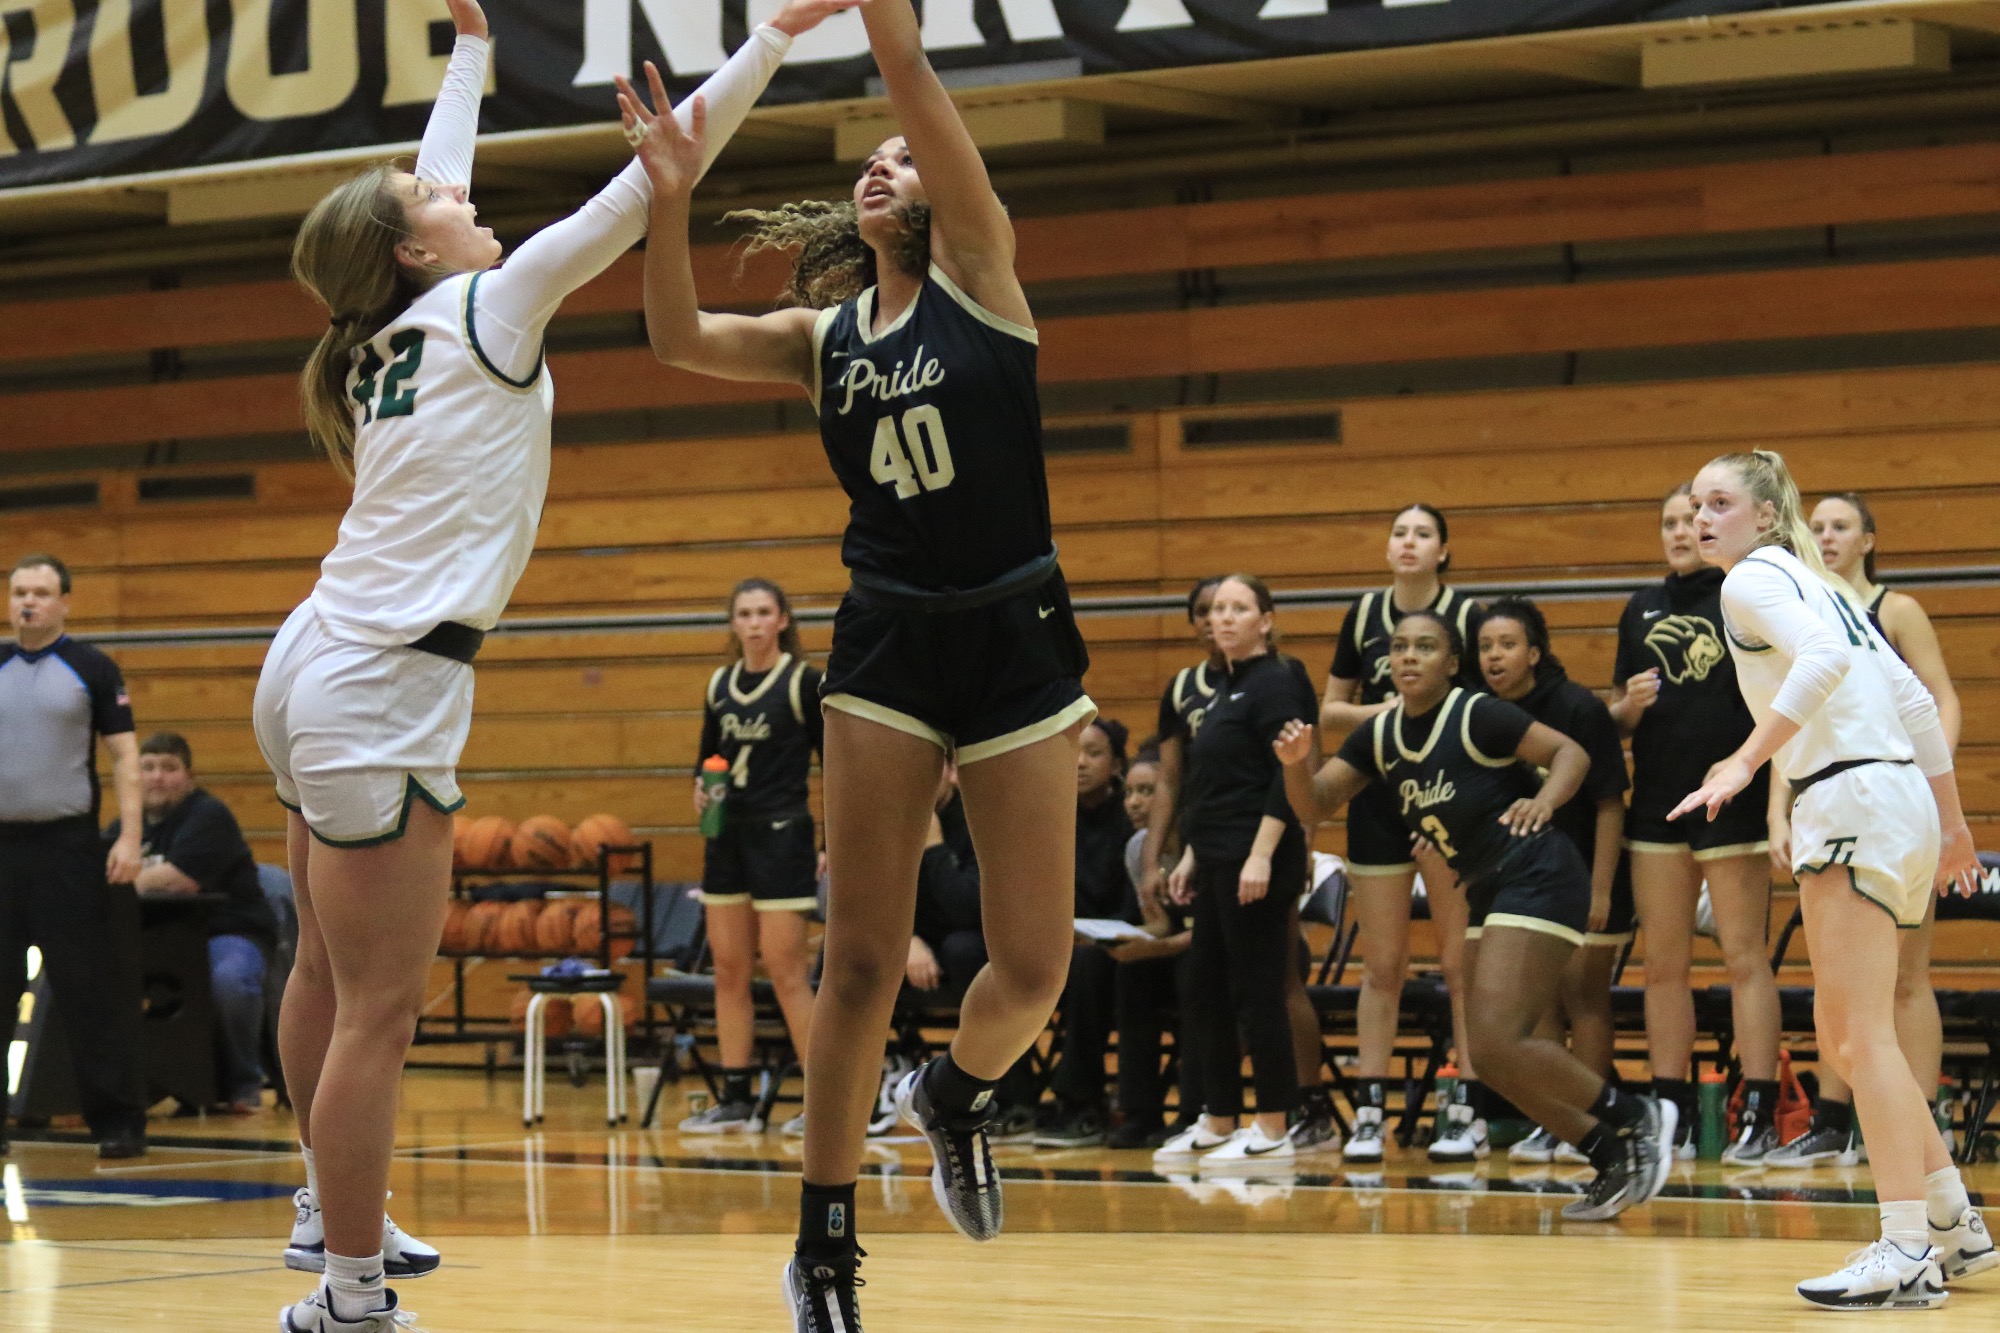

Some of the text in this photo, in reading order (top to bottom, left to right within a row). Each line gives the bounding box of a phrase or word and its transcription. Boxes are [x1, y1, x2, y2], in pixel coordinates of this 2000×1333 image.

[837, 344, 945, 415] Pride
[869, 403, 955, 500] 40
[720, 712, 771, 741] Pride
[1399, 769, 1456, 815] Pride
